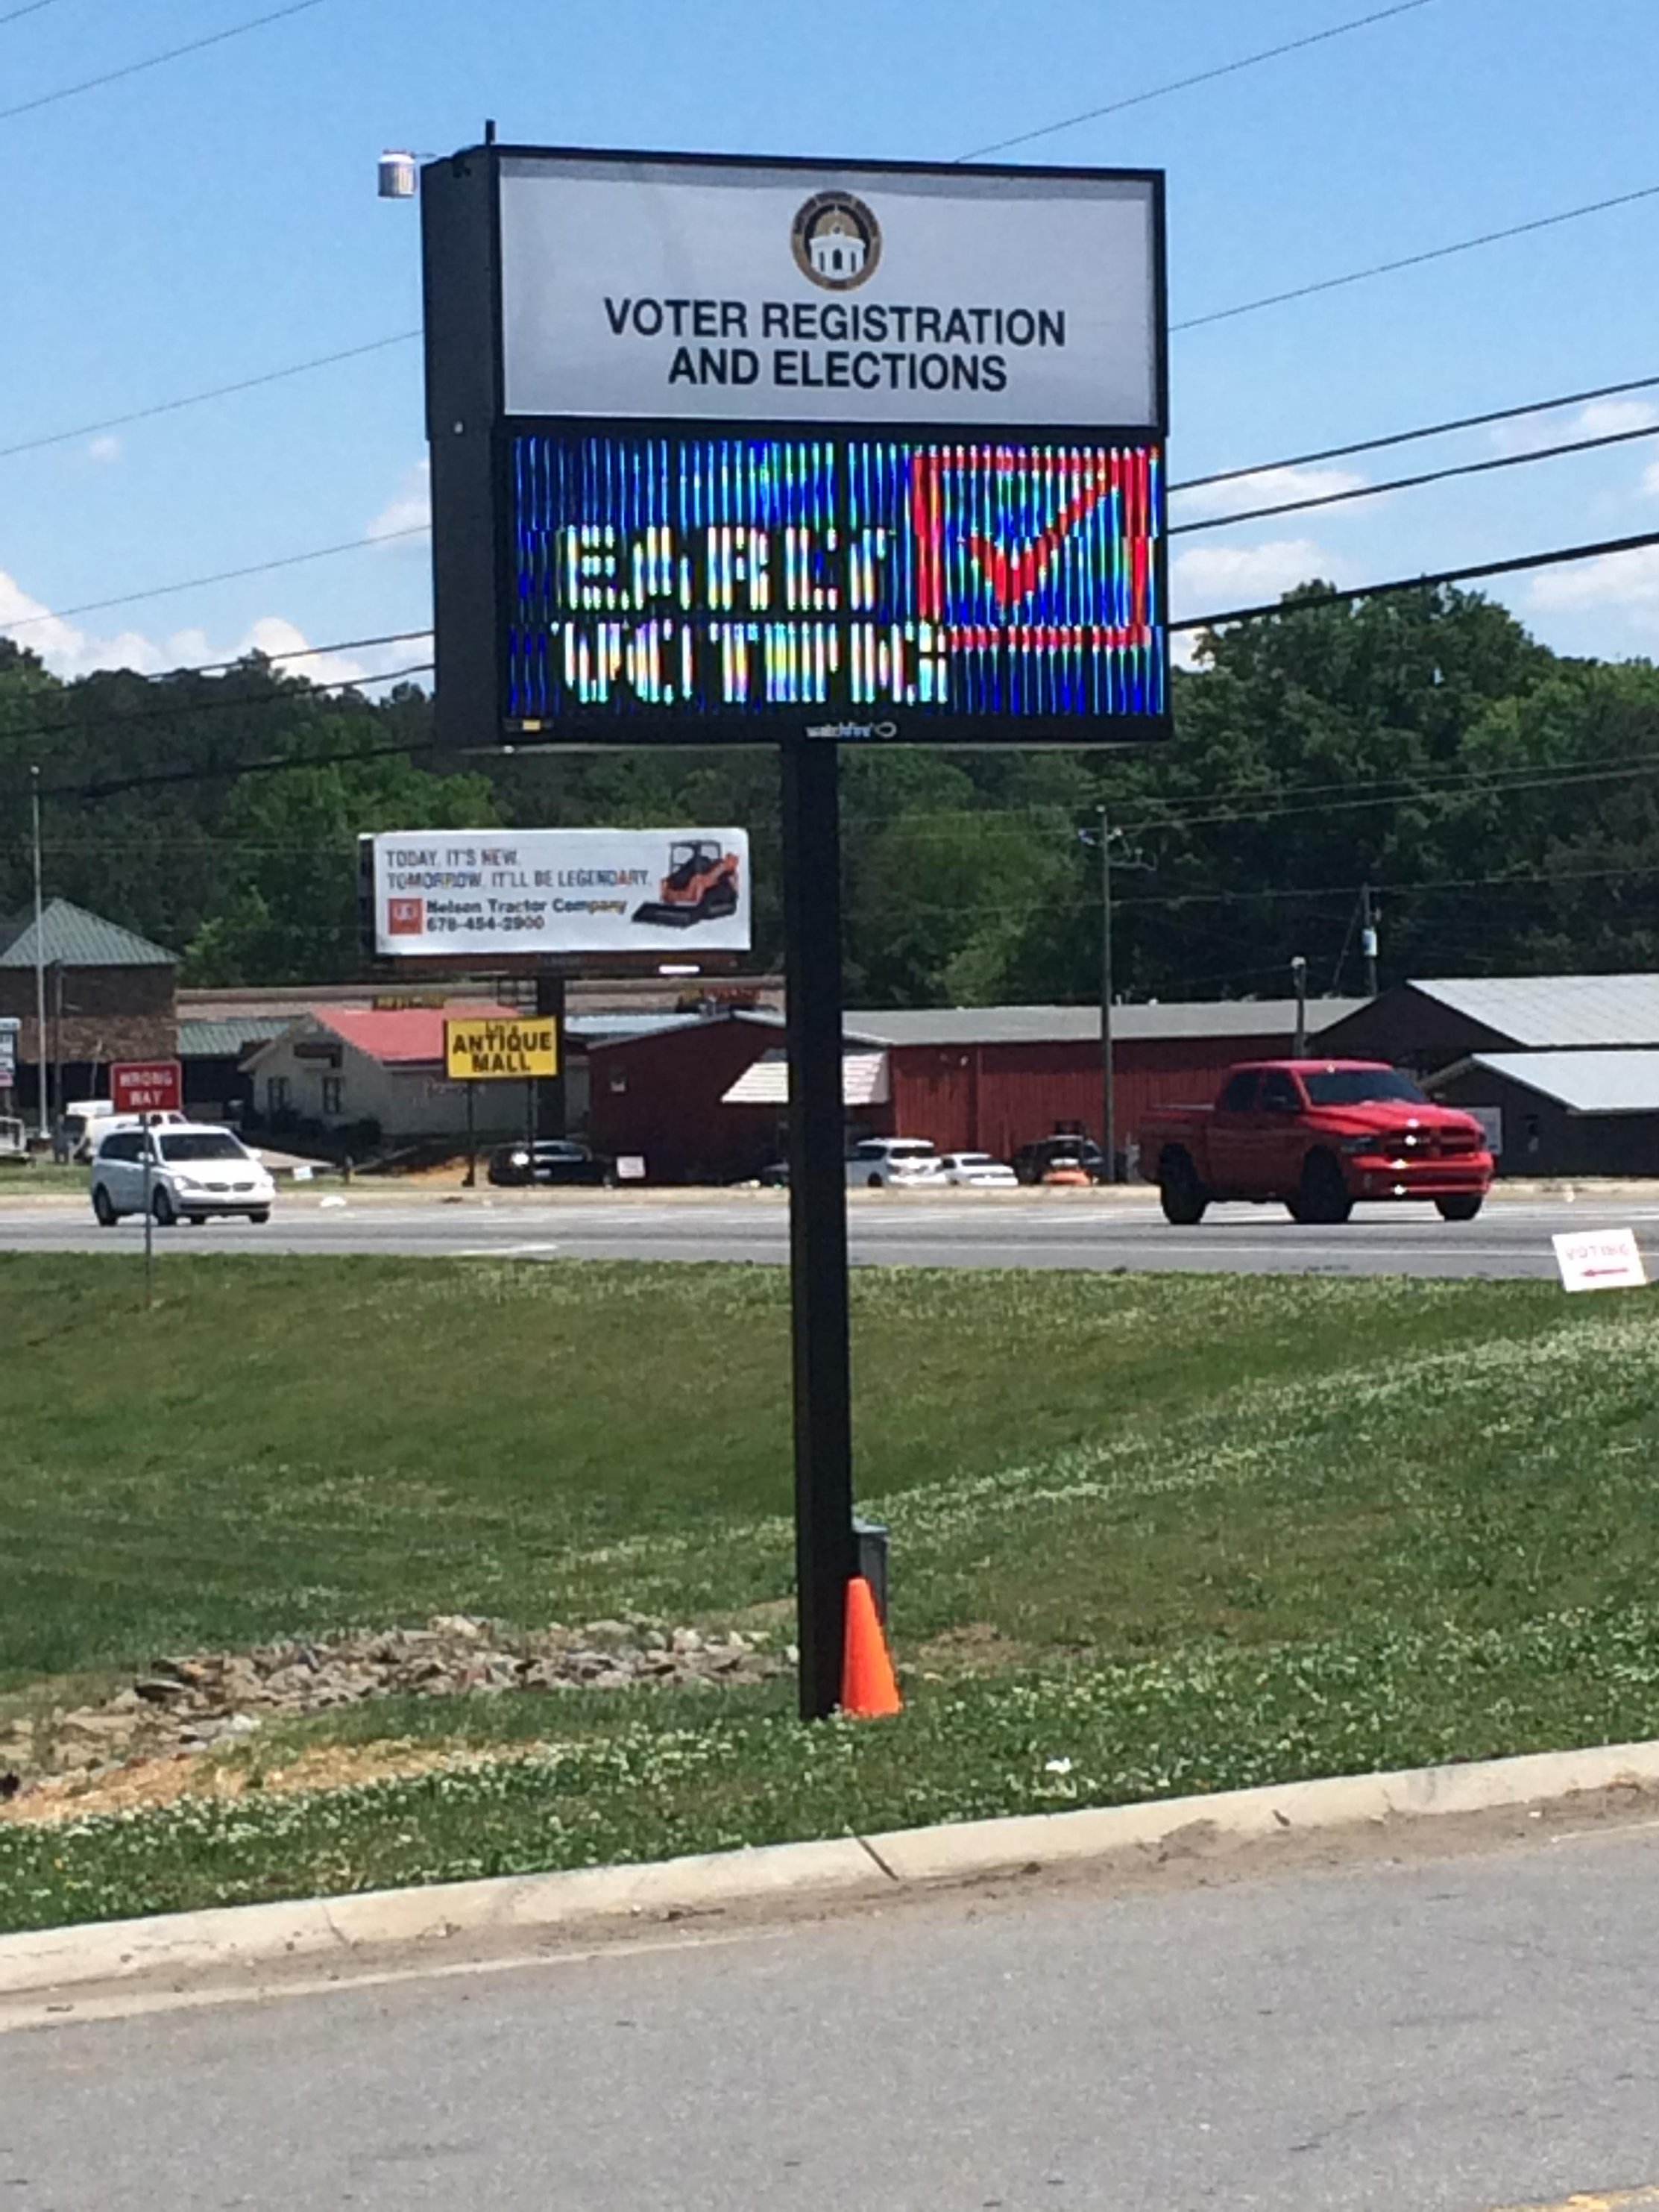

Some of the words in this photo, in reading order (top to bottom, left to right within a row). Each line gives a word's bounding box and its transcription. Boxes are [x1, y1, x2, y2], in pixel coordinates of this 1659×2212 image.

[604, 296, 748, 338] VOTER
[761, 301, 1065, 347] REGISTRATION
[668, 347, 760, 386] AND
[772, 350, 1007, 392] ELECTIONS
[566, 524, 887, 611] EARLY
[550, 620, 948, 705] VOTING
[447, 848, 477, 867] IT'S
[492, 870, 529, 887] IT'LL
[535, 869, 553, 887] BE
[426, 898, 482, 914] Nelson
[487, 897, 547, 914] Tractor
[552, 897, 628, 915] Company
[453, 1031, 553, 1053] ANTIQUE
[471, 1053, 532, 1072] MALL
[120, 1069, 173, 1087] WRONG
[130, 1090, 163, 1105] WAY
[1565, 1242, 1630, 1260] VOTING
